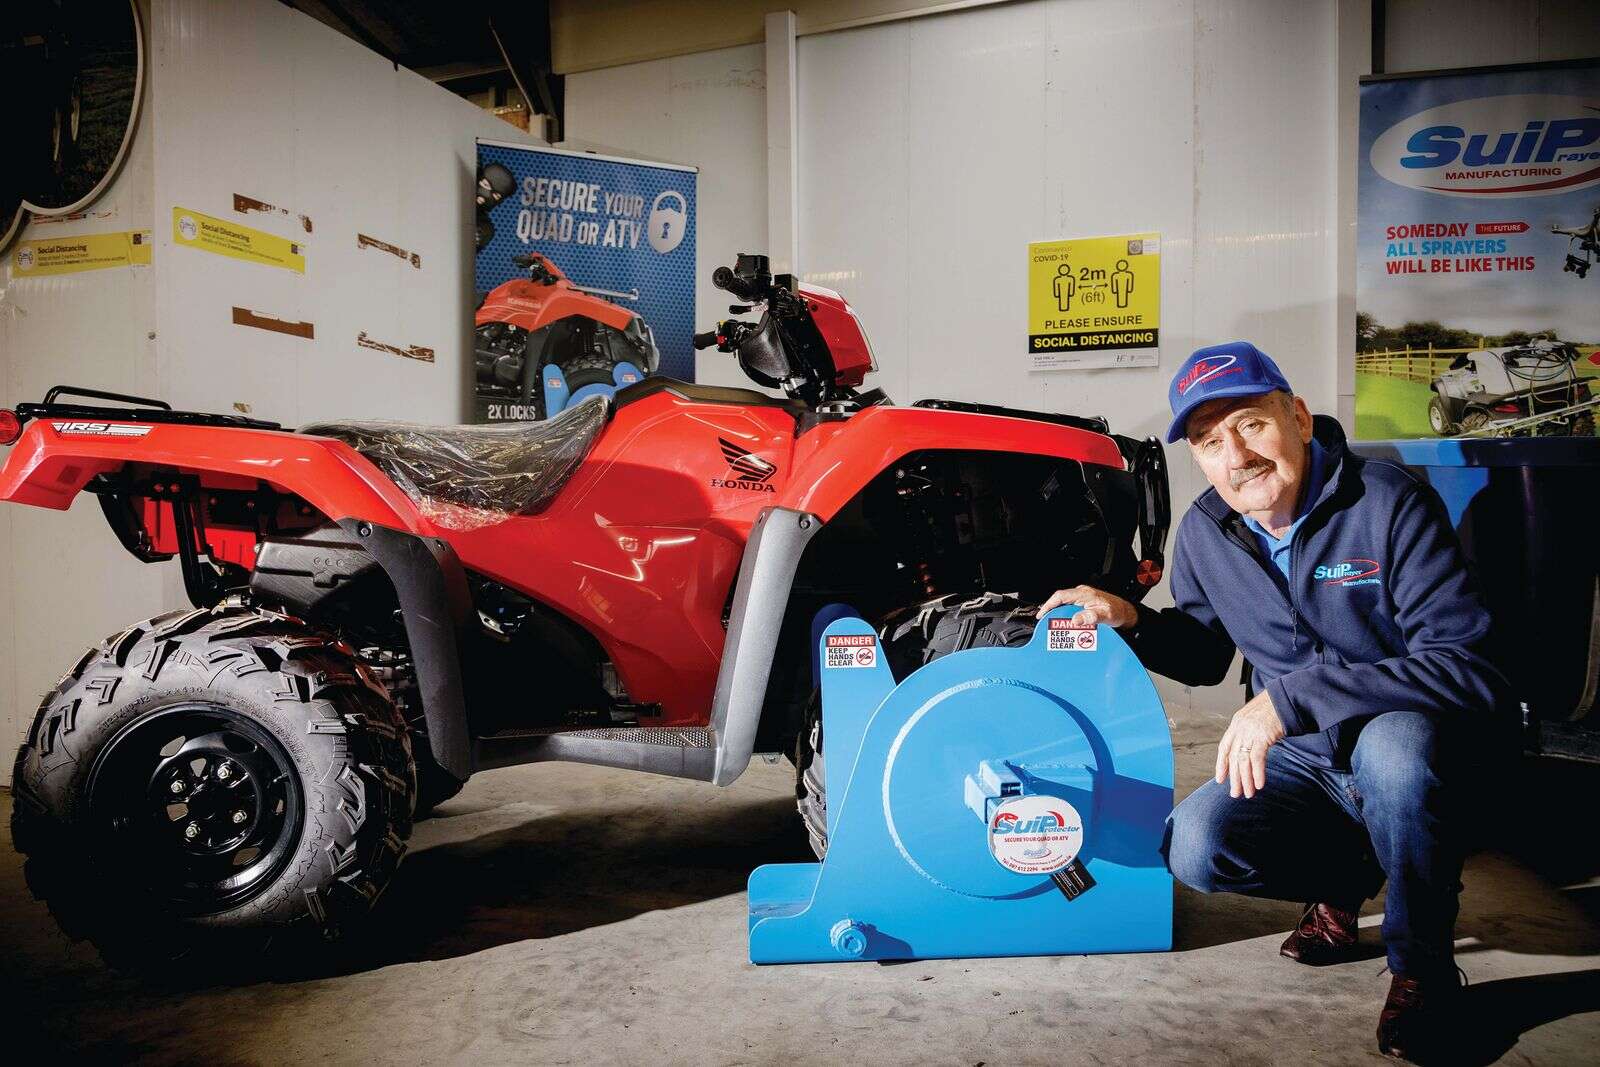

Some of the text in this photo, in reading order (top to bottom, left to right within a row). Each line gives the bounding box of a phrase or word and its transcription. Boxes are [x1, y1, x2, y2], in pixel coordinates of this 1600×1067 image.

[1445, 168, 1562, 181] MANUFACTURING
[522, 176, 644, 217] SECURE YOUR
[201, 221, 218, 233] Social
[220, 227, 250, 243] Distancing
[516, 209, 642, 250] QUAD OR ATV
[1386, 222, 1469, 240] SOMEDAY
[1480, 223, 1521, 233] THE FUTURE
[38, 243, 87, 254] Social Distancing
[1386, 239, 1507, 257] ALL SPRAYERS
[1033, 254, 1069, 263] COVID-19
[1386, 256, 1536, 275] WILL BE LIKE THIS
[1079, 267, 1106, 281] 2m
[1081, 291, 1106, 305] (6ft)
[1045, 315, 1142, 330] PLEASE ENSURE
[1034, 332, 1154, 349] SOCIAL DISTANCING
[488, 404, 536, 420] 2X LOCKS
[62, 422, 109, 431] IRS
[711, 479, 776, 492] HONDA
[829, 636, 873, 646] DANGER
